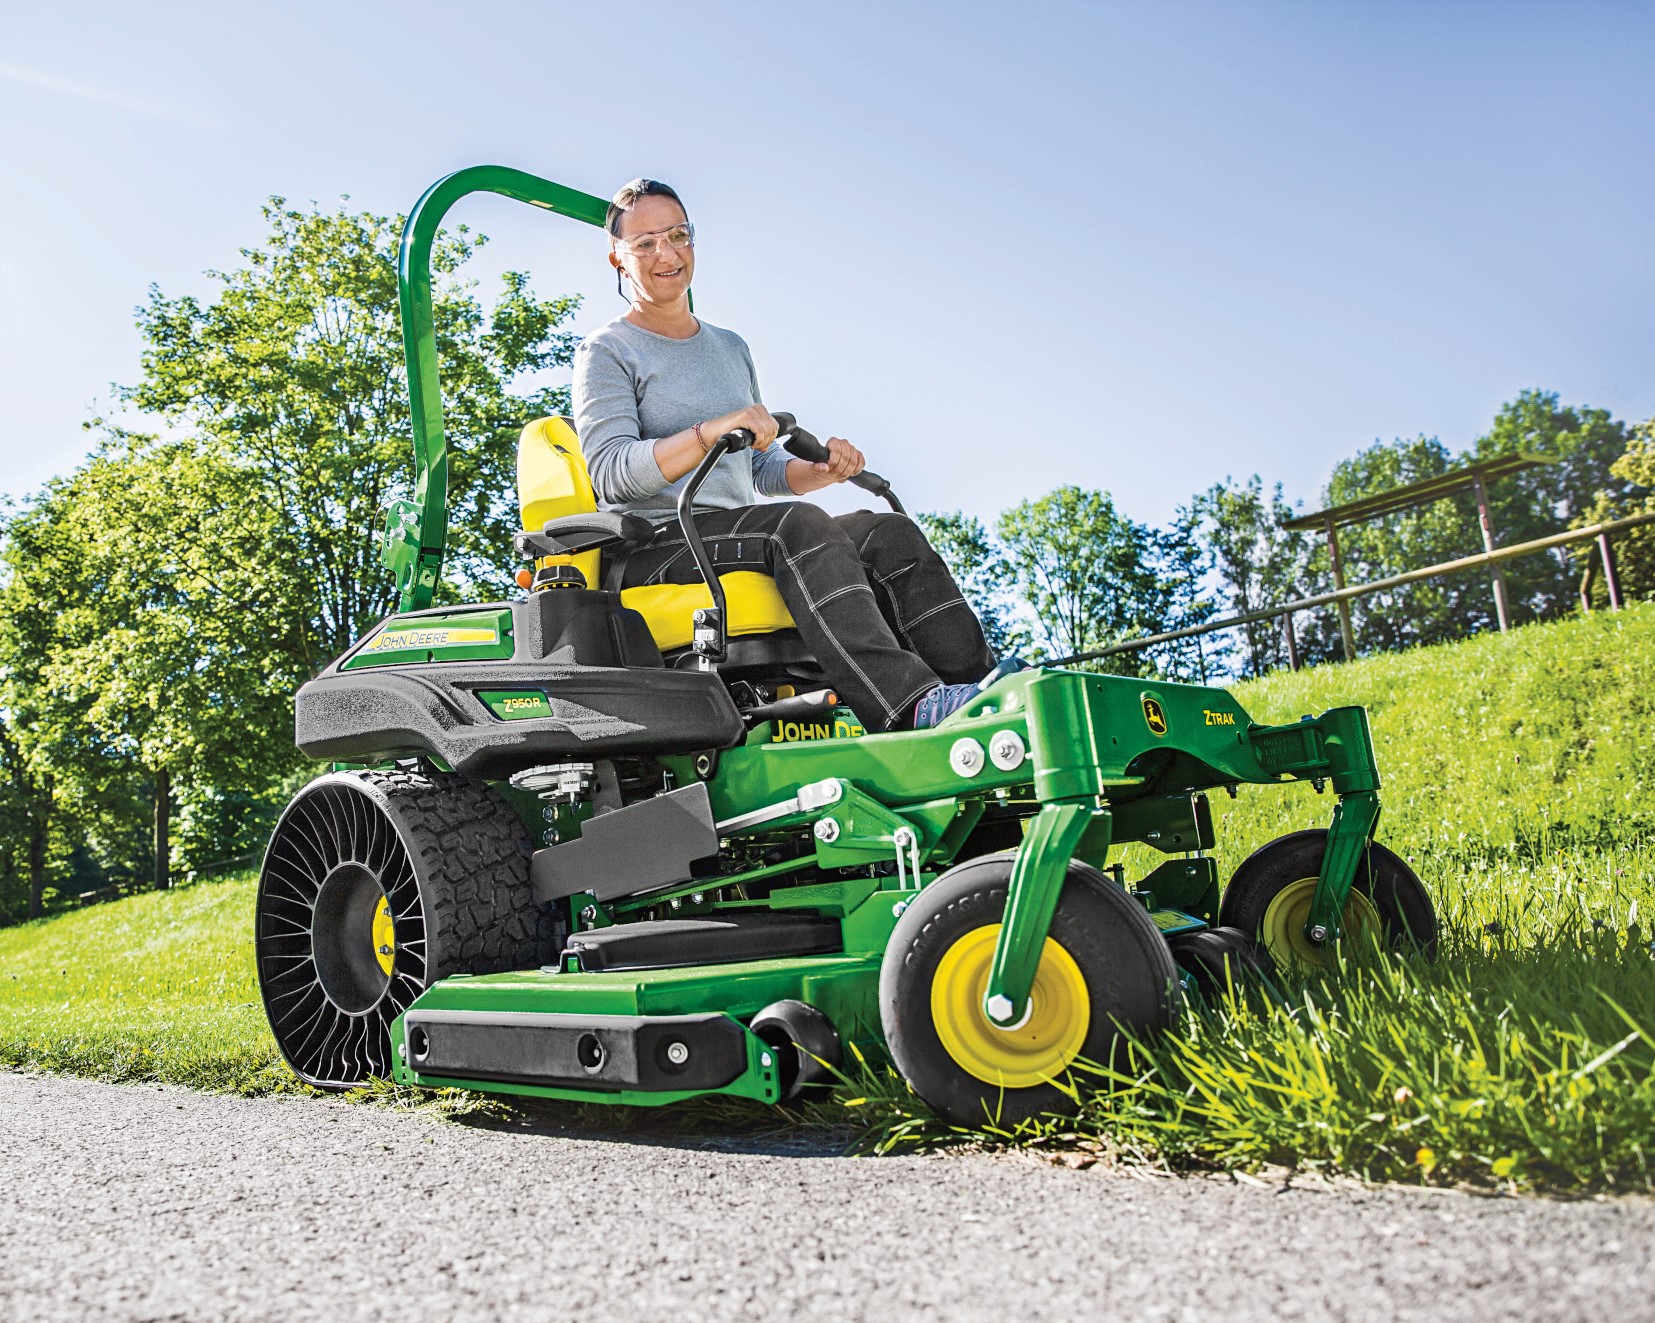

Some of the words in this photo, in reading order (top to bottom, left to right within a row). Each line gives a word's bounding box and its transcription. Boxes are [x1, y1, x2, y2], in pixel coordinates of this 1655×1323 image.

[376, 635, 407, 649] JOHN
[409, 632, 449, 646] DEERE
[503, 697, 542, 713] Z950R
[1203, 709, 1236, 726] ZTRAK
[772, 719, 831, 743] JOHN
